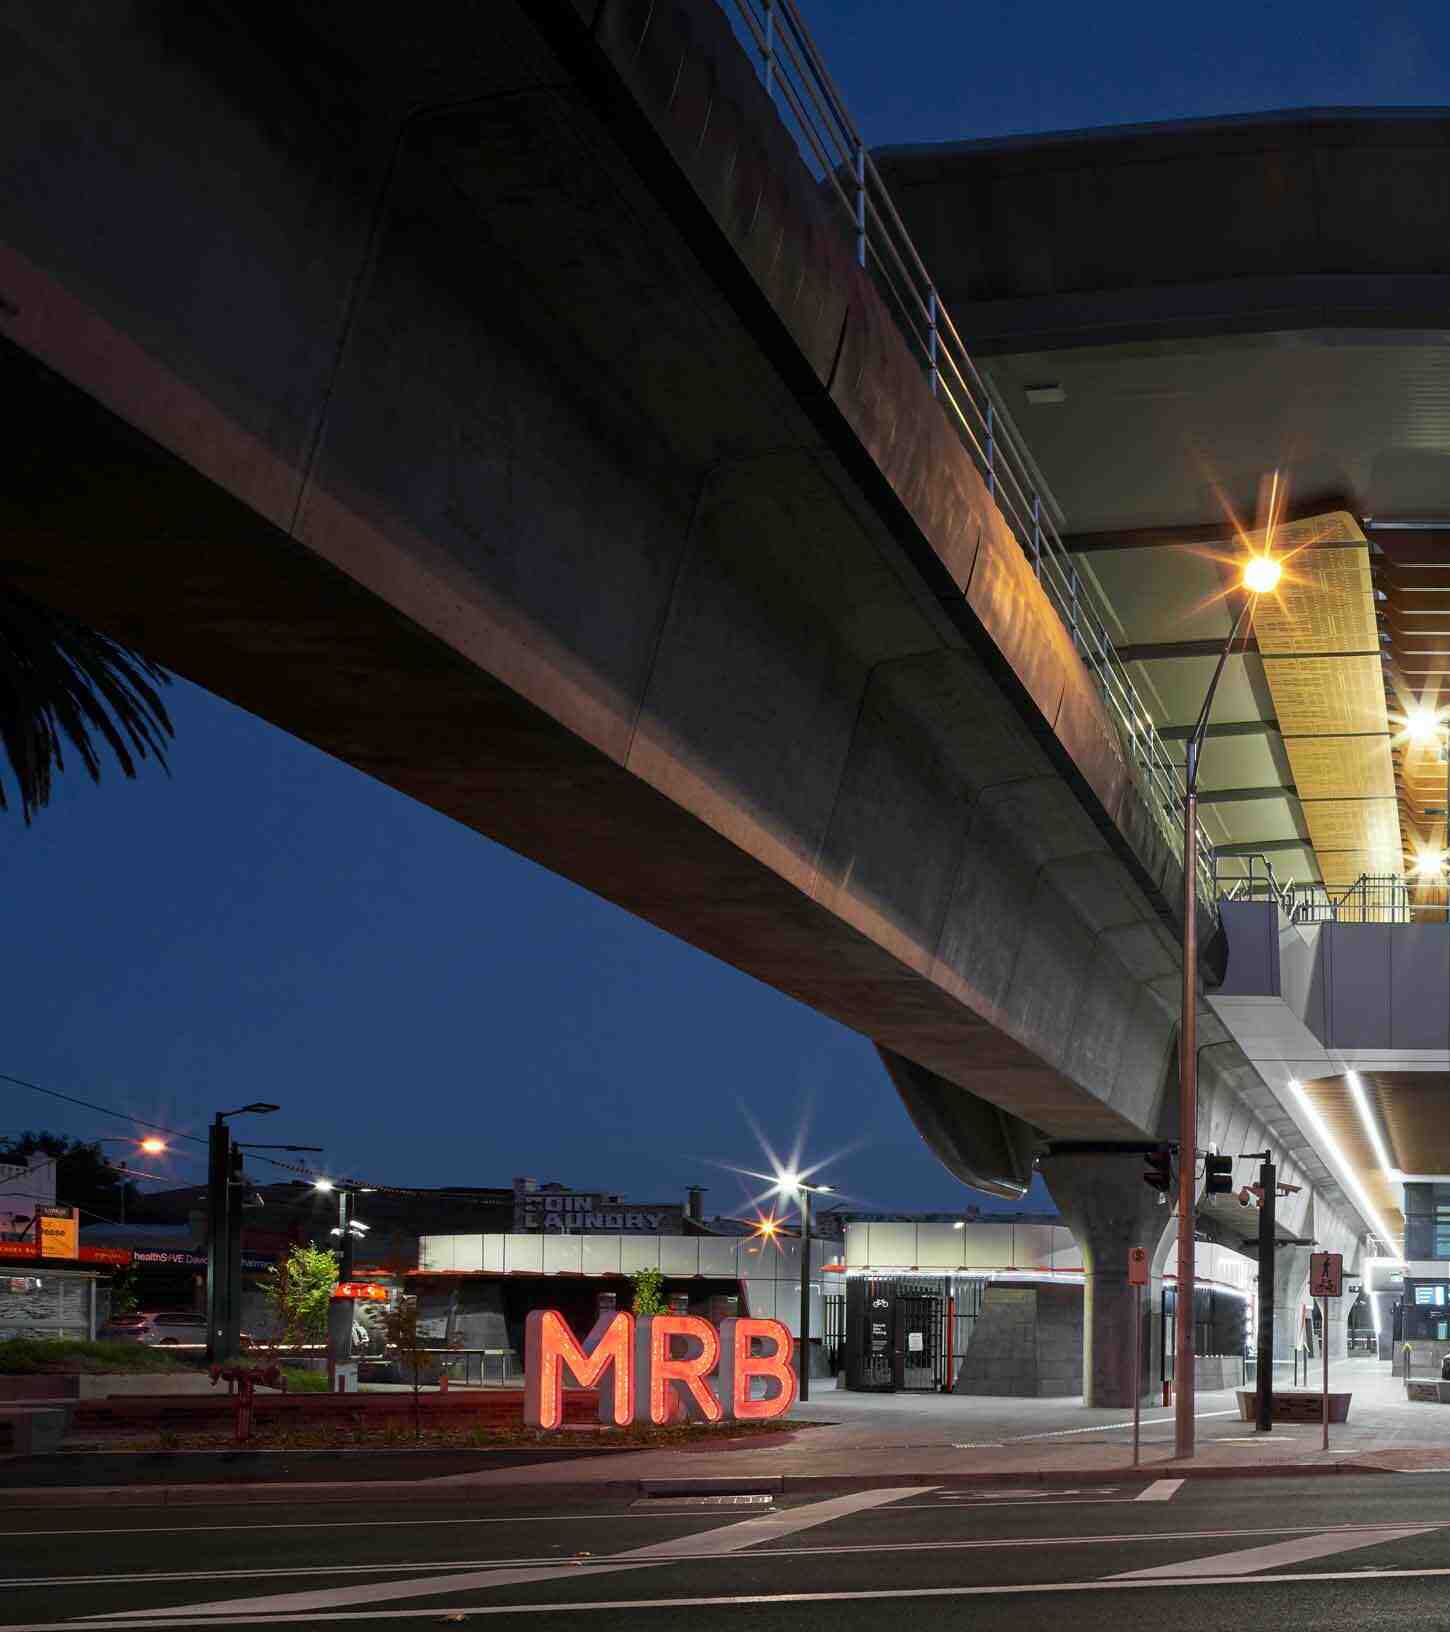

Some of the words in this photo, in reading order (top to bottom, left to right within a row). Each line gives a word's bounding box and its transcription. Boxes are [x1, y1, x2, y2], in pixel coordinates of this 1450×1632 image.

[525, 1196, 592, 1212] COIN
[525, 1212, 664, 1229] LAUNDRY
[526, 1309, 797, 1428] MRB
